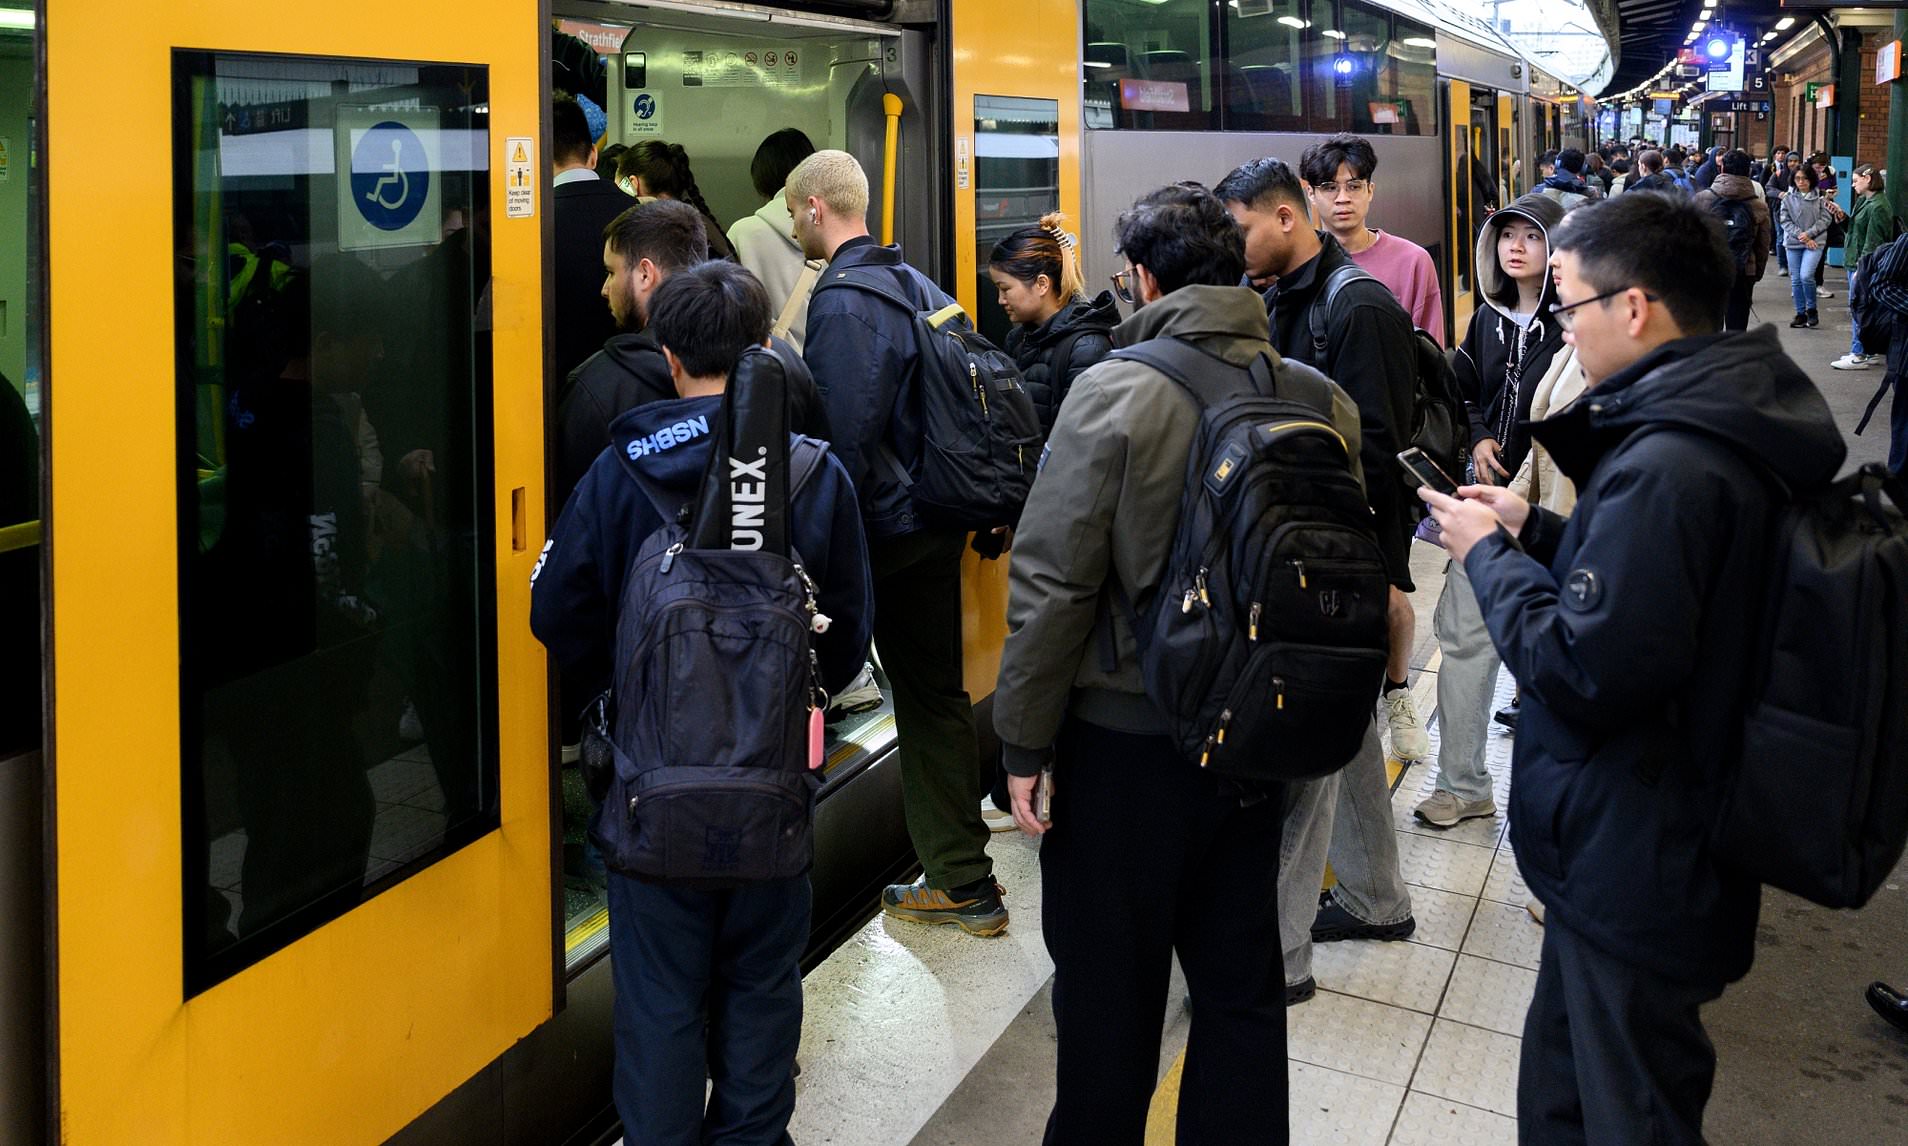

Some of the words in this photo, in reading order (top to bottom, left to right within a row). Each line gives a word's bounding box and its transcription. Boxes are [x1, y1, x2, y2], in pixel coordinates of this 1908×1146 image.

[887, 47, 897, 62] 3
[1754, 77, 1763, 88] 5
[1731, 101, 1748, 111] Lift
